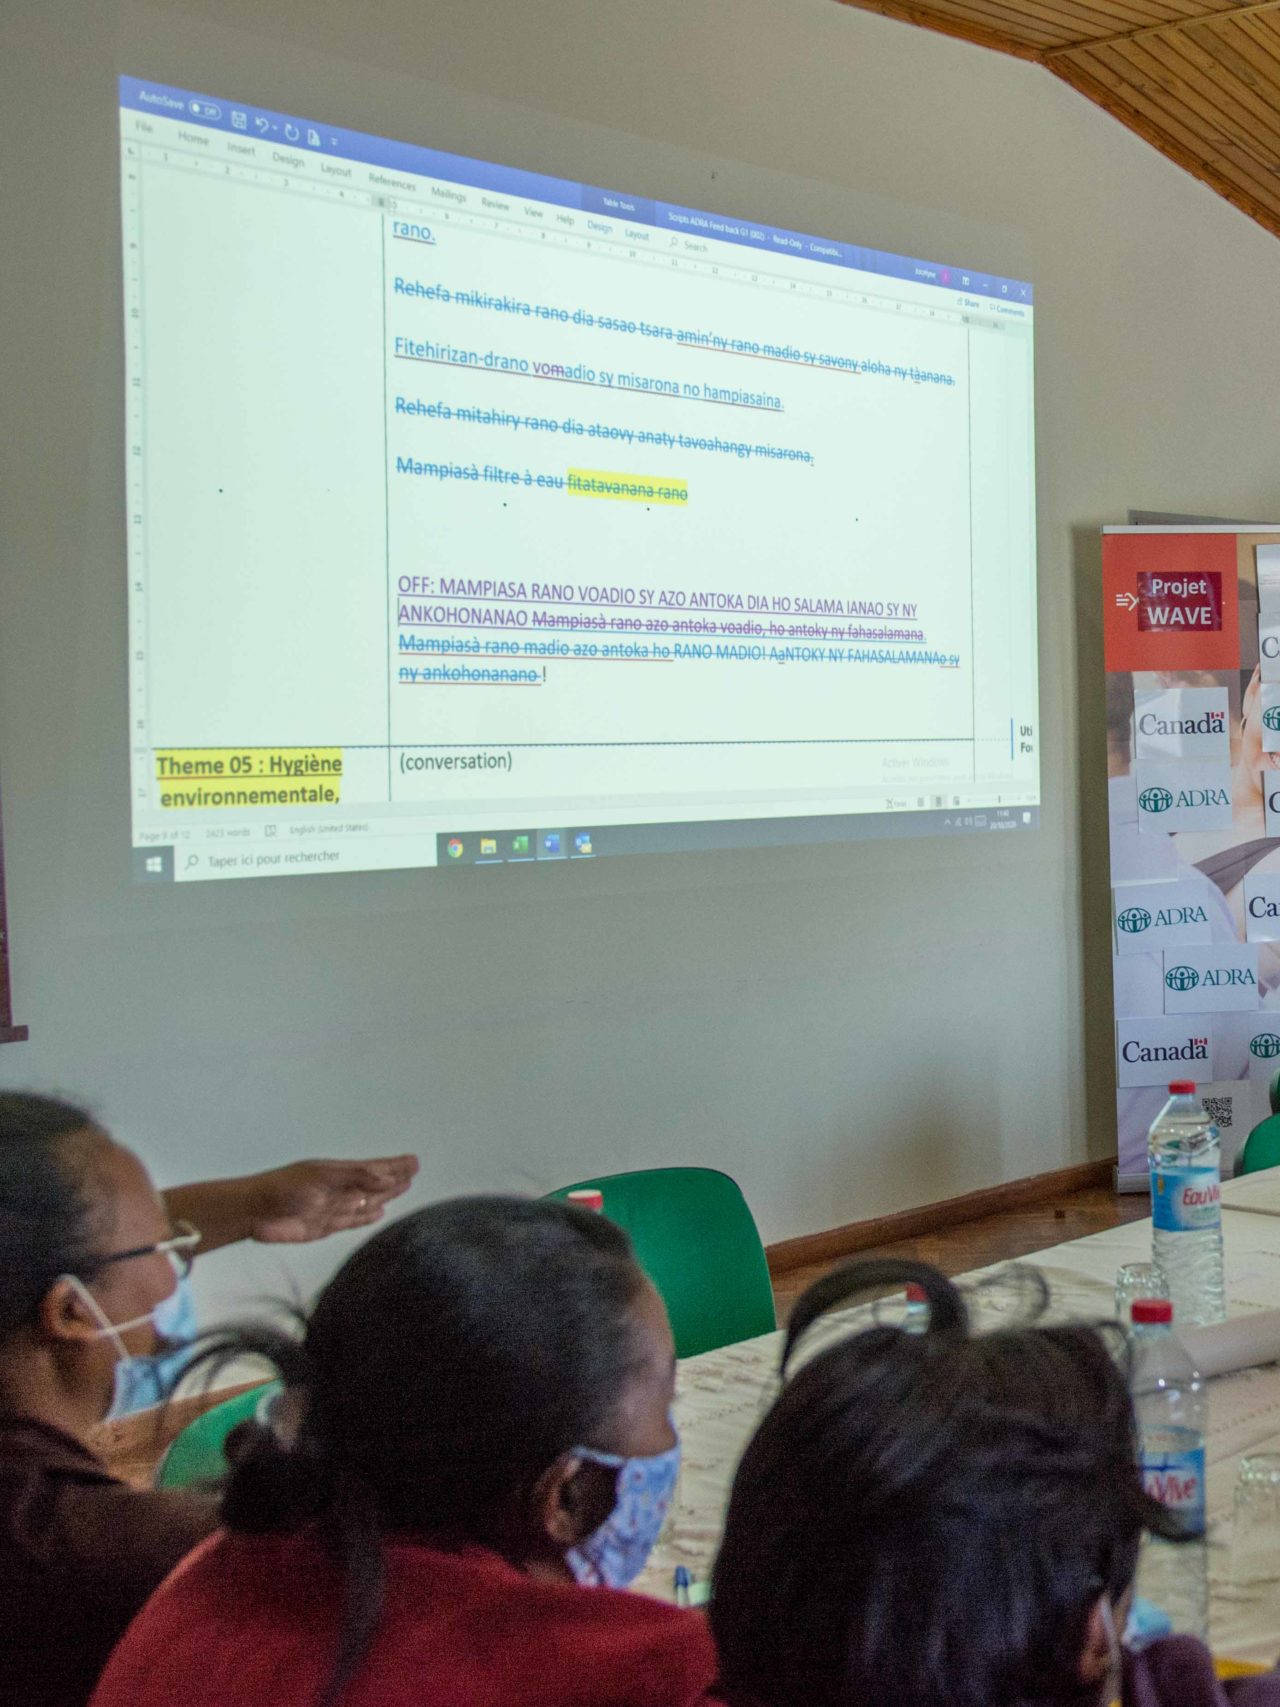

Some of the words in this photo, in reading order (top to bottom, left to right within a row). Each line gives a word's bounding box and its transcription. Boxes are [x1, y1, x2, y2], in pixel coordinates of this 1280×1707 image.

[139, 91, 184, 111] AutoSave
[136, 120, 153, 133] File
[178, 131, 209, 147] Home
[228, 141, 255, 156] Insert
[273, 151, 305, 168] Design
[321, 162, 352, 178] Layout
[368, 173, 416, 192] References
[431, 186, 467, 203] Mailings
[482, 197, 510, 211] Review
[525, 206, 543, 218] View
[556, 214, 575, 226] Help
[393, 219, 436, 242] rano.
[587, 220, 613, 235] Design
[625, 228, 649, 242] Layout
[684, 241, 708, 253] Search
[394, 276, 450, 303] Rehefa
[455, 289, 531, 316] mikirakira
[535, 304, 569, 322] rano
[572, 309, 595, 327] dia
[597, 315, 637, 334] sasao
[639, 320, 673, 340] tsara
[731, 338, 760, 354] rano
[763, 343, 801, 361] madio
[803, 350, 816, 366] sy
[818, 352, 859, 373] savony
[861, 358, 891, 376] aloha
[894, 365, 908, 381] ny
[395, 337, 529, 372] Fitehirizan-drano
[599, 371, 614, 388] sy
[617, 371, 679, 394] misarona
[683, 383, 701, 397] no
[704, 383, 785, 409] hampiasaina.
[395, 397, 451, 420] Rehefa
[456, 406, 521, 431] mitahiry
[524, 416, 558, 432] rano
[562, 418, 584, 435] dia
[588, 423, 634, 445] ataovy
[638, 430, 676, 450] anaty
[678, 434, 752, 458] tavoahangy
[396, 456, 479, 481] Mampiasà
[483, 465, 520, 485] filtre
[523, 470, 533, 486] à
[537, 474, 564, 489] eau
[567, 473, 654, 499] fitatavanana
[658, 488, 688, 501] rano
[398, 575, 435, 594] OFF:
[440, 577, 527, 600] MAMPIASA
[532, 582, 574, 601] RANO
[578, 585, 635, 604] VOADIO
[639, 589, 655, 605] SY
[658, 590, 686, 607] AZO
[690, 592, 744, 610] ANTOKA
[747, 595, 769, 611] DIA
[772, 597, 791, 612] HO
[794, 597, 844, 614] SALAMA
[847, 600, 884, 616] IANAO
[887, 603, 899, 617] SY
[902, 603, 917, 617] NY
[1152, 578, 1207, 597] Projet
[398, 604, 528, 627] ANKOHONANAO
[610, 616, 642, 631] rano
[645, 618, 669, 632] azo
[672, 618, 717, 634] antoka
[769, 621, 785, 636] ho
[788, 622, 828, 641] antoky
[831, 627, 845, 641] ny
[1147, 606, 1212, 625] WAVE
[398, 633, 480, 656] Mampiasà
[485, 641, 519, 654] rano
[524, 639, 569, 656] madio
[573, 643, 597, 656] azo
[601, 642, 648, 658] antoka
[652, 642, 670, 658] ho
[674, 643, 712, 660] RANO
[716, 644, 766, 661] MADIO!
[829, 648, 845, 664] NY
[949, 653, 960, 667] sy
[398, 666, 418, 684] ny
[423, 663, 538, 682] ankohonanano
[1139, 712, 1226, 736] Canada
[157, 756, 224, 775] Theme
[229, 756, 253, 774] 05
[269, 755, 342, 776] Hygiène
[400, 751, 512, 774] (conversation)
[160, 784, 340, 808] environnementale,
[1176, 788, 1231, 808] ADRA
[139, 831, 159, 842] Page
[227, 828, 250, 838] words
[290, 824, 315, 837] English
[208, 854, 238, 870] Taper
[241, 853, 253, 866] ici
[256, 853, 281, 868] pour
[284, 850, 340, 864] rechercher
[1154, 905, 1208, 927] ADRA
[1201, 968, 1256, 987] ADRA
[1122, 1038, 1208, 1063] Canada
